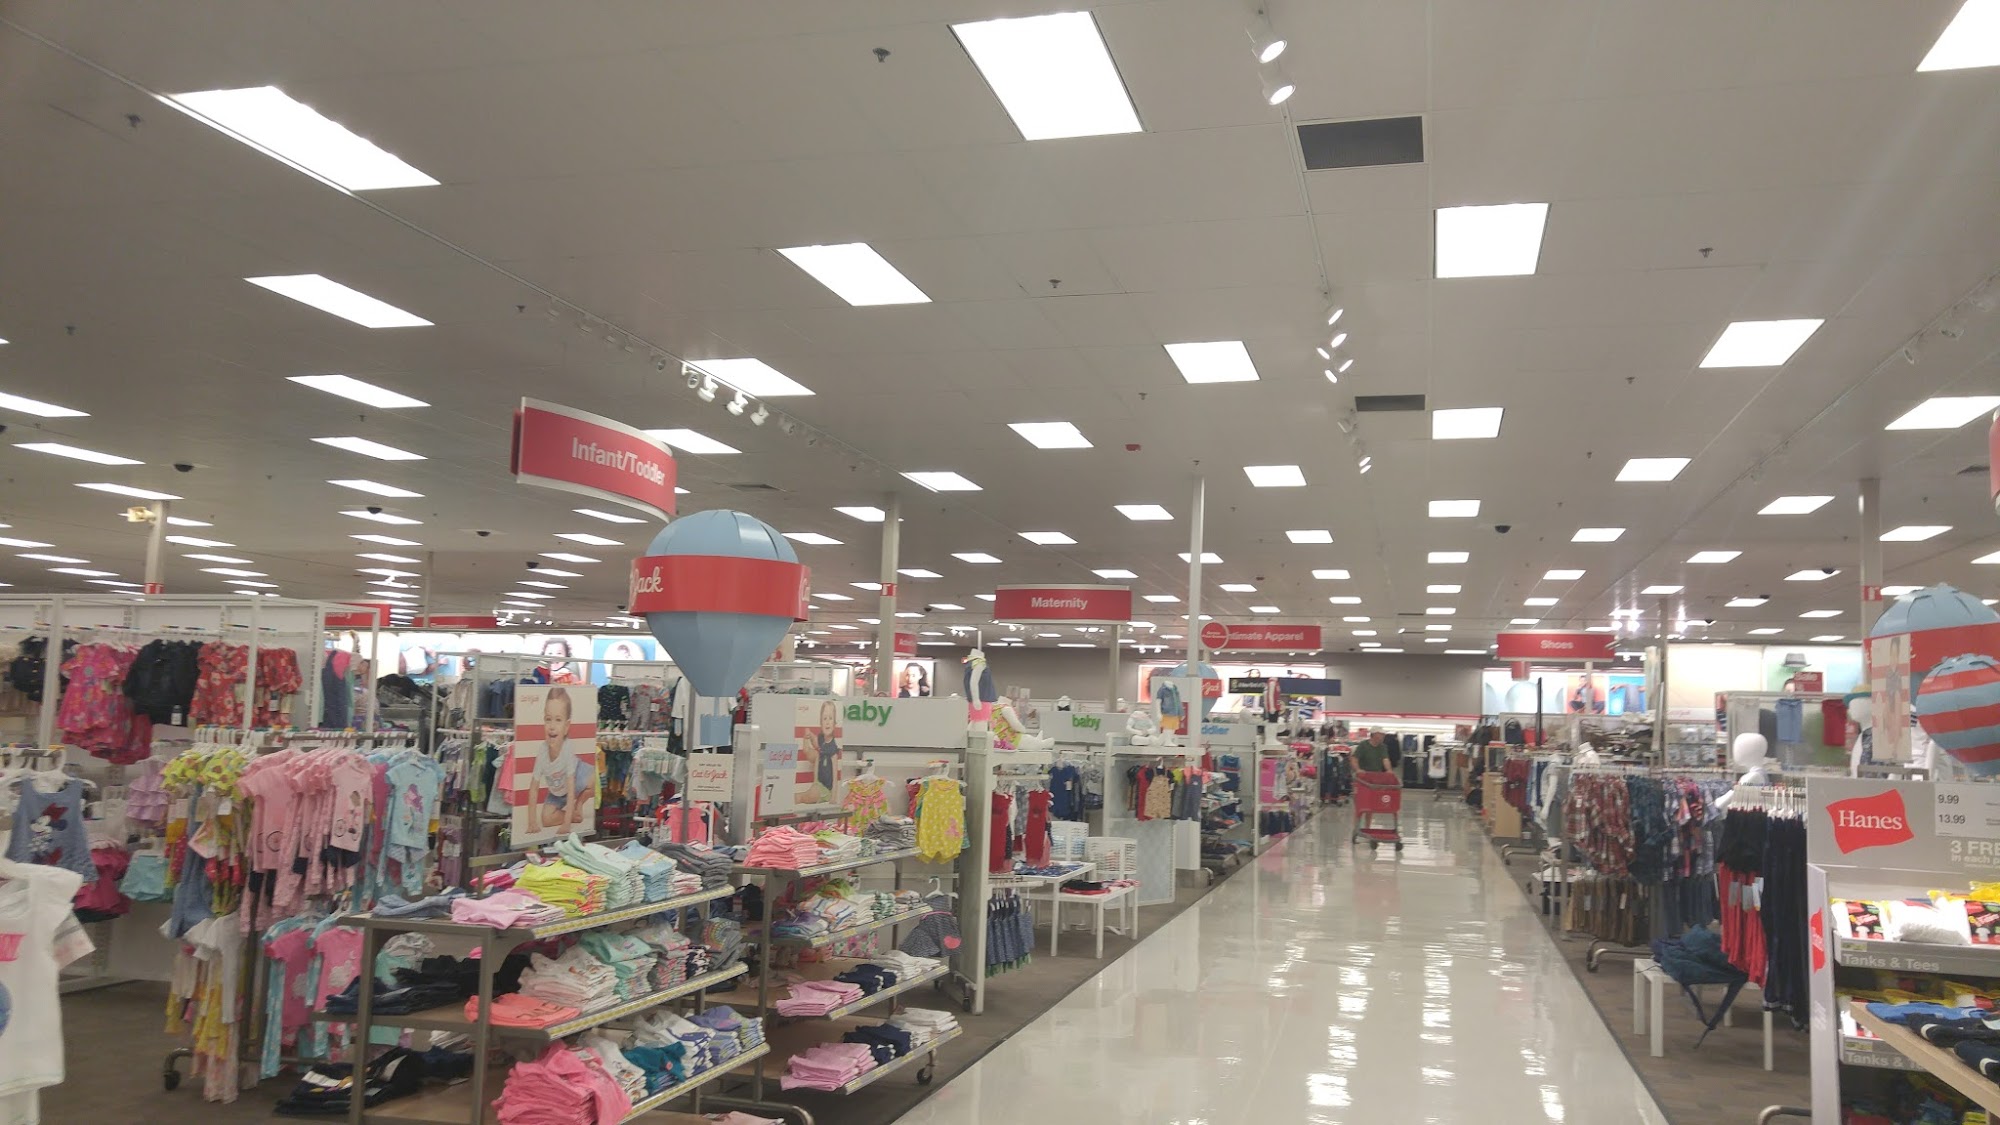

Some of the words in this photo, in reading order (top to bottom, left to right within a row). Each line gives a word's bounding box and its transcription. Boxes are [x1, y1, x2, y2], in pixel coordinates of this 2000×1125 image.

[571, 436, 666, 487] Infant/Toddler
[1031, 597, 1088, 610] Maternity
[1227, 632, 1262, 641] ntimate
[1264, 632, 1304, 642] Apparel
[1540, 639, 1574, 650] Shoes
[843, 700, 893, 727] aby
[1072, 714, 1101, 731] baby
[1201, 726, 1230, 734] ddler
[1938, 794, 1959, 804] 9.99
[1838, 810, 1903, 830] Hanes
[1939, 814, 1966, 824] 13.99
[1951, 840, 1962, 854] 3
[1951, 853, 1962, 862] in
[1964, 855, 1991, 864] each
[1844, 953, 1886, 968] Tanks
[1890, 956, 1901, 969] &
[1906, 958, 1940, 972] Tees
[1845, 1051, 1889, 1067] Tanks
[1892, 1056, 1904, 1068] &
